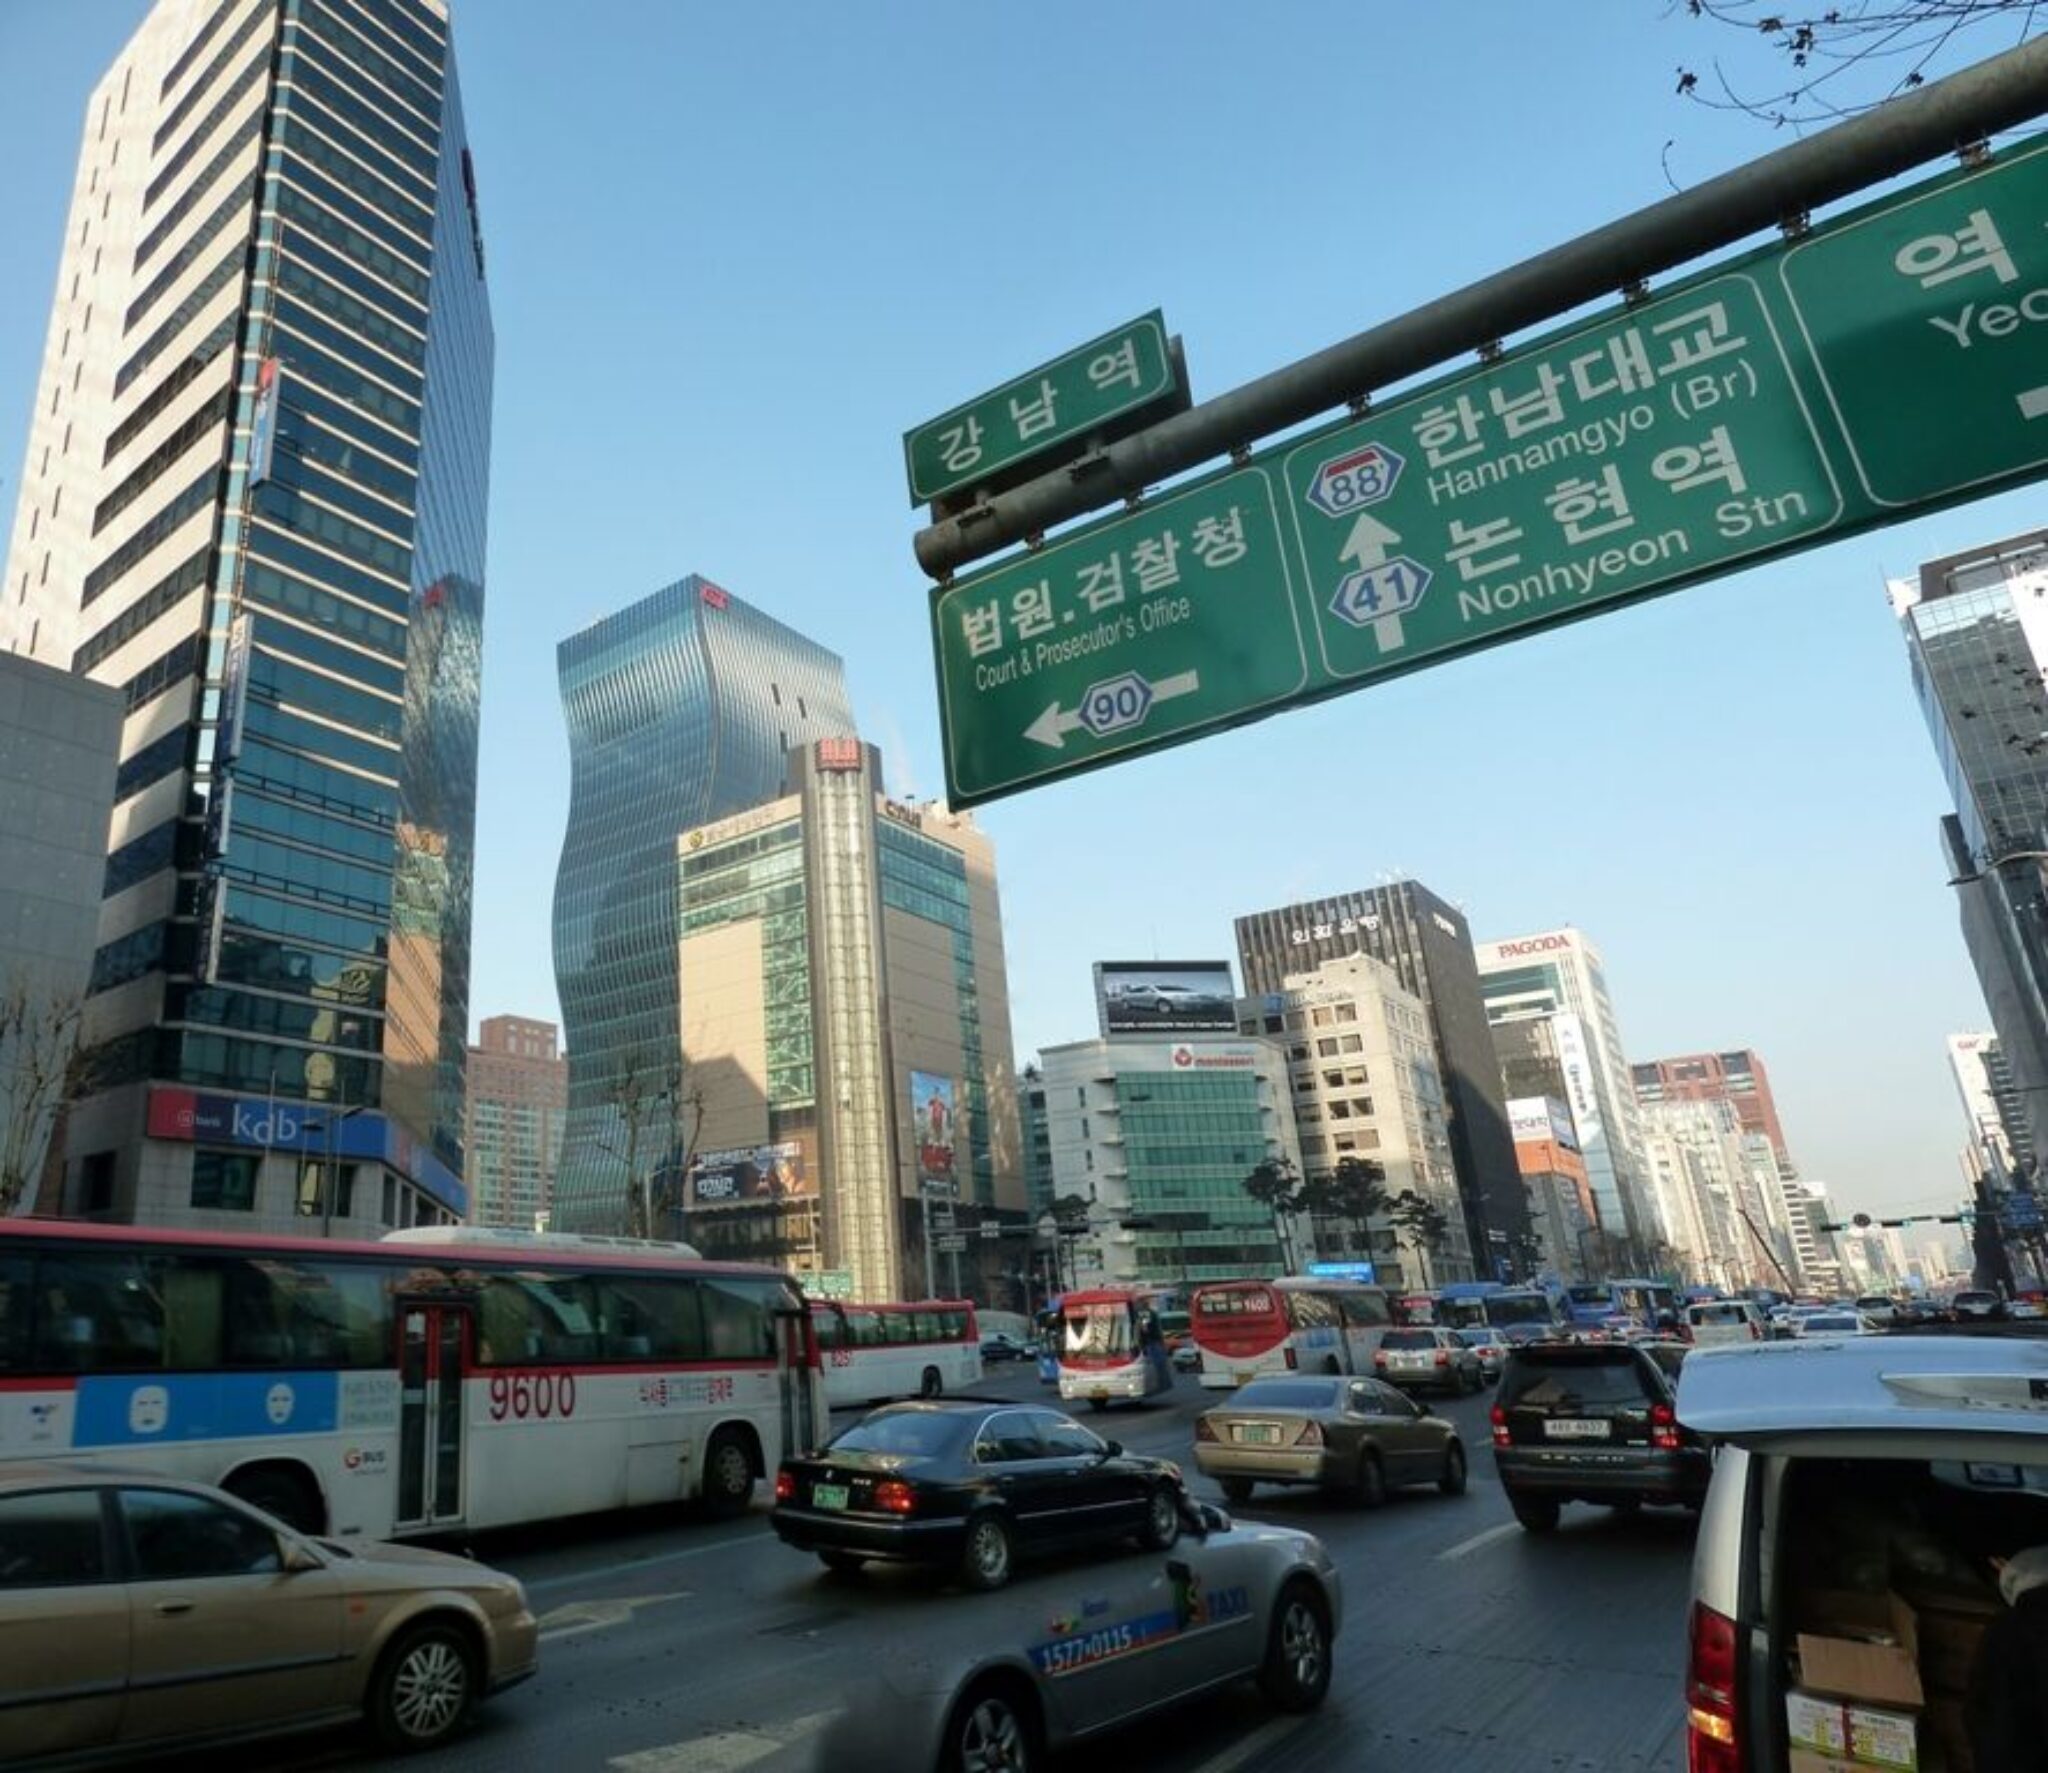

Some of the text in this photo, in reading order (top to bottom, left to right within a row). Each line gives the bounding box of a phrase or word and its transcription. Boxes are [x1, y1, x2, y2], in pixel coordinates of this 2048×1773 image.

[1894, 207, 2048, 290] 역
[1412, 300, 1748, 469] 한남대교
[1427, 358, 1758, 505] Hannamgyo (Br)
[1331, 460, 1384, 505] 88
[1458, 489, 1808, 622] Nonhyeon Stn
[1351, 562, 1410, 614] 41
[975, 596, 1191, 692] Court & Prosecutor's Office
[1091, 684, 1139, 727] 90
[1498, 934, 1572, 960] PAGODA
[231, 1102, 297, 1146] kdb
[488, 1371, 576, 1422] 9600
